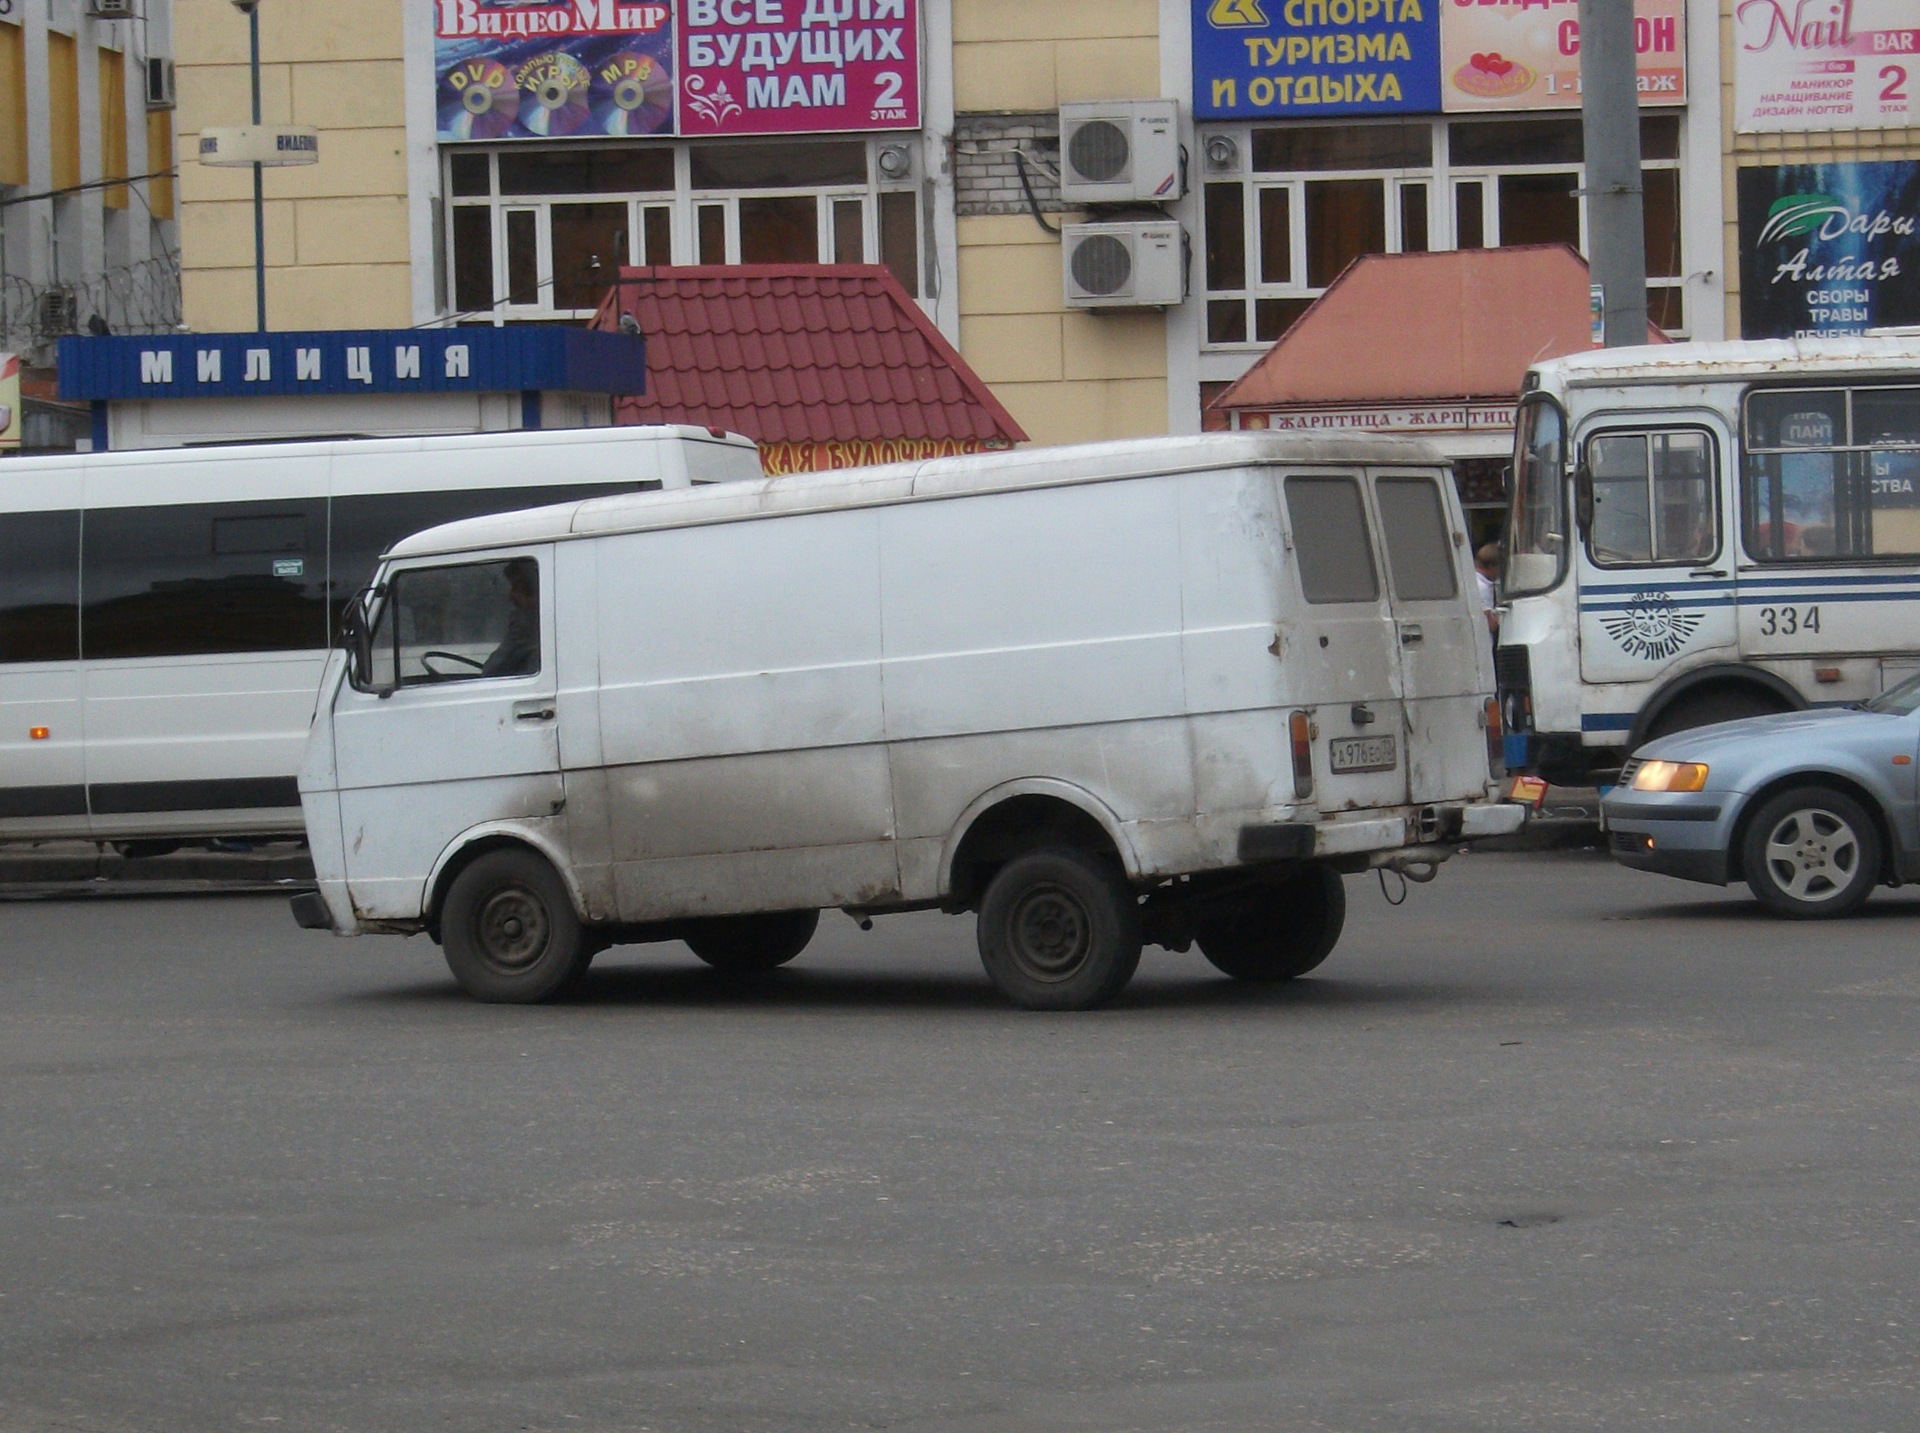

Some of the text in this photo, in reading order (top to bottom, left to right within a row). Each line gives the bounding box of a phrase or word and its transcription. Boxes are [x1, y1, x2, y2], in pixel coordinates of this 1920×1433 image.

[687, 0, 906, 29] ВСЕ ДЛЯ
[1284, 0, 1423, 27] СПОРТА
[1737, 0, 1914, 51] Nail BAR
[688, 28, 905, 72] БУДУЩИХ
[1244, 33, 1411, 66] ТУРИЗМА
[1558, 17, 1676, 56] СОН
[450, 64, 505, 91] DVD
[526, 66, 577, 92] ИГРЫ
[746, 71, 904, 108] МАМ 2
[1248, 73, 1402, 106] ОТДЫХА
[1790, 79, 1854, 90] МАНИКЮР
[1878, 65, 1908, 101] 2
[1752, 104, 1854, 118] ДИЗАЙН НОГТЕЙ
[1760, 91, 1854, 103] НАРАЩИВАНИЕ
[1879, 104, 1909, 113] ЭТАЖ
[870, 109, 907, 120] ЭТАЖ
[1800, 206, 1915, 243] Дары
[1771, 248, 1900, 284] Алтая
[1807, 290, 1869, 304] СБОРЫ
[1809, 308, 1868, 322] ТРАВЫ
[140, 344, 469, 384] МИЛИЦИЯ
[1279, 410, 1517, 429] ЖАРПТИЦА ЖАРПТИЦ
[1760, 605, 1821, 636] 334
[1620, 632, 1687, 661] БРЯНСК
